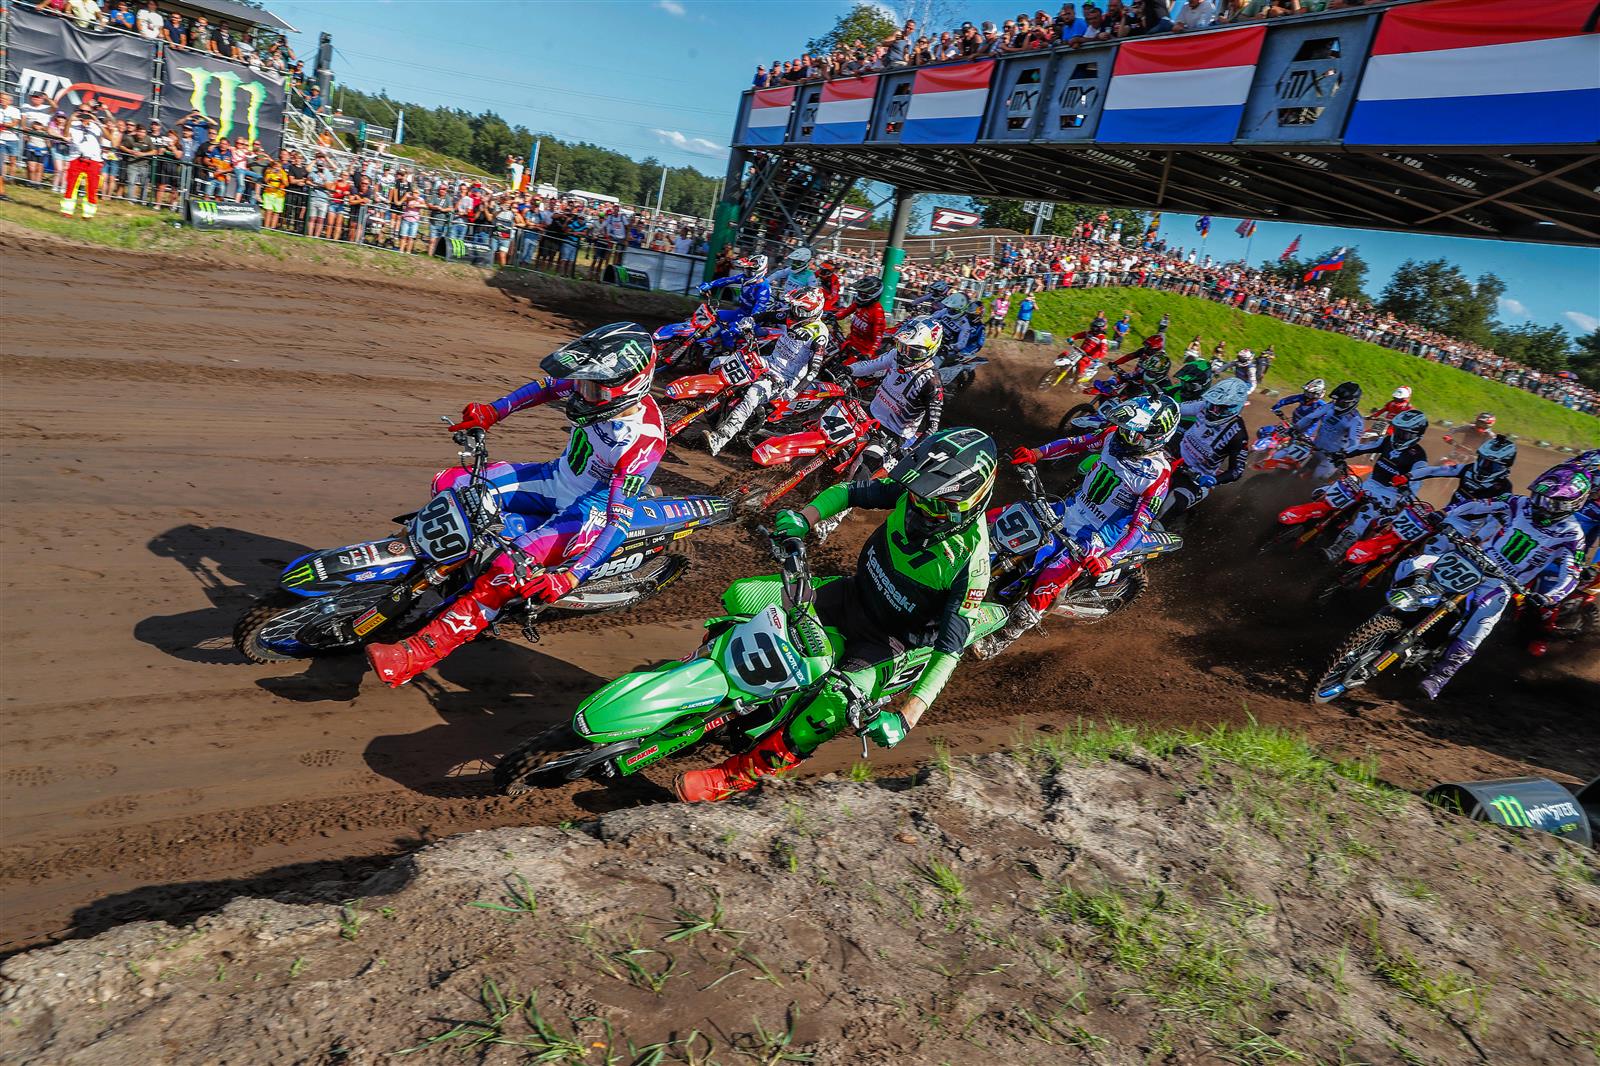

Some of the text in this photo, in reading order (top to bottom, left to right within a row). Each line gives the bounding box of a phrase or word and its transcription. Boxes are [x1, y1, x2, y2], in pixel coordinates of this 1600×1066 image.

[723, 358, 748, 384] 92
[794, 401, 811, 411] 92
[822, 416, 855, 441] 41
[1214, 422, 1242, 450] THOR
[418, 496, 467, 559] 959
[997, 510, 1038, 549] 91
[1392, 514, 1423, 540] 243
[313, 557, 329, 581] YAMAHA
[588, 552, 645, 581] 959
[866, 544, 917, 614] Kawasaki
[1096, 568, 1122, 588] 91
[1433, 555, 1479, 590] 259
[866, 562, 902, 612] Racing Team
[769, 607, 782, 630] MXGP
[731, 632, 788, 686] 3
[627, 745, 659, 767] BRAKING
[1525, 802, 1580, 825] MONSTER
